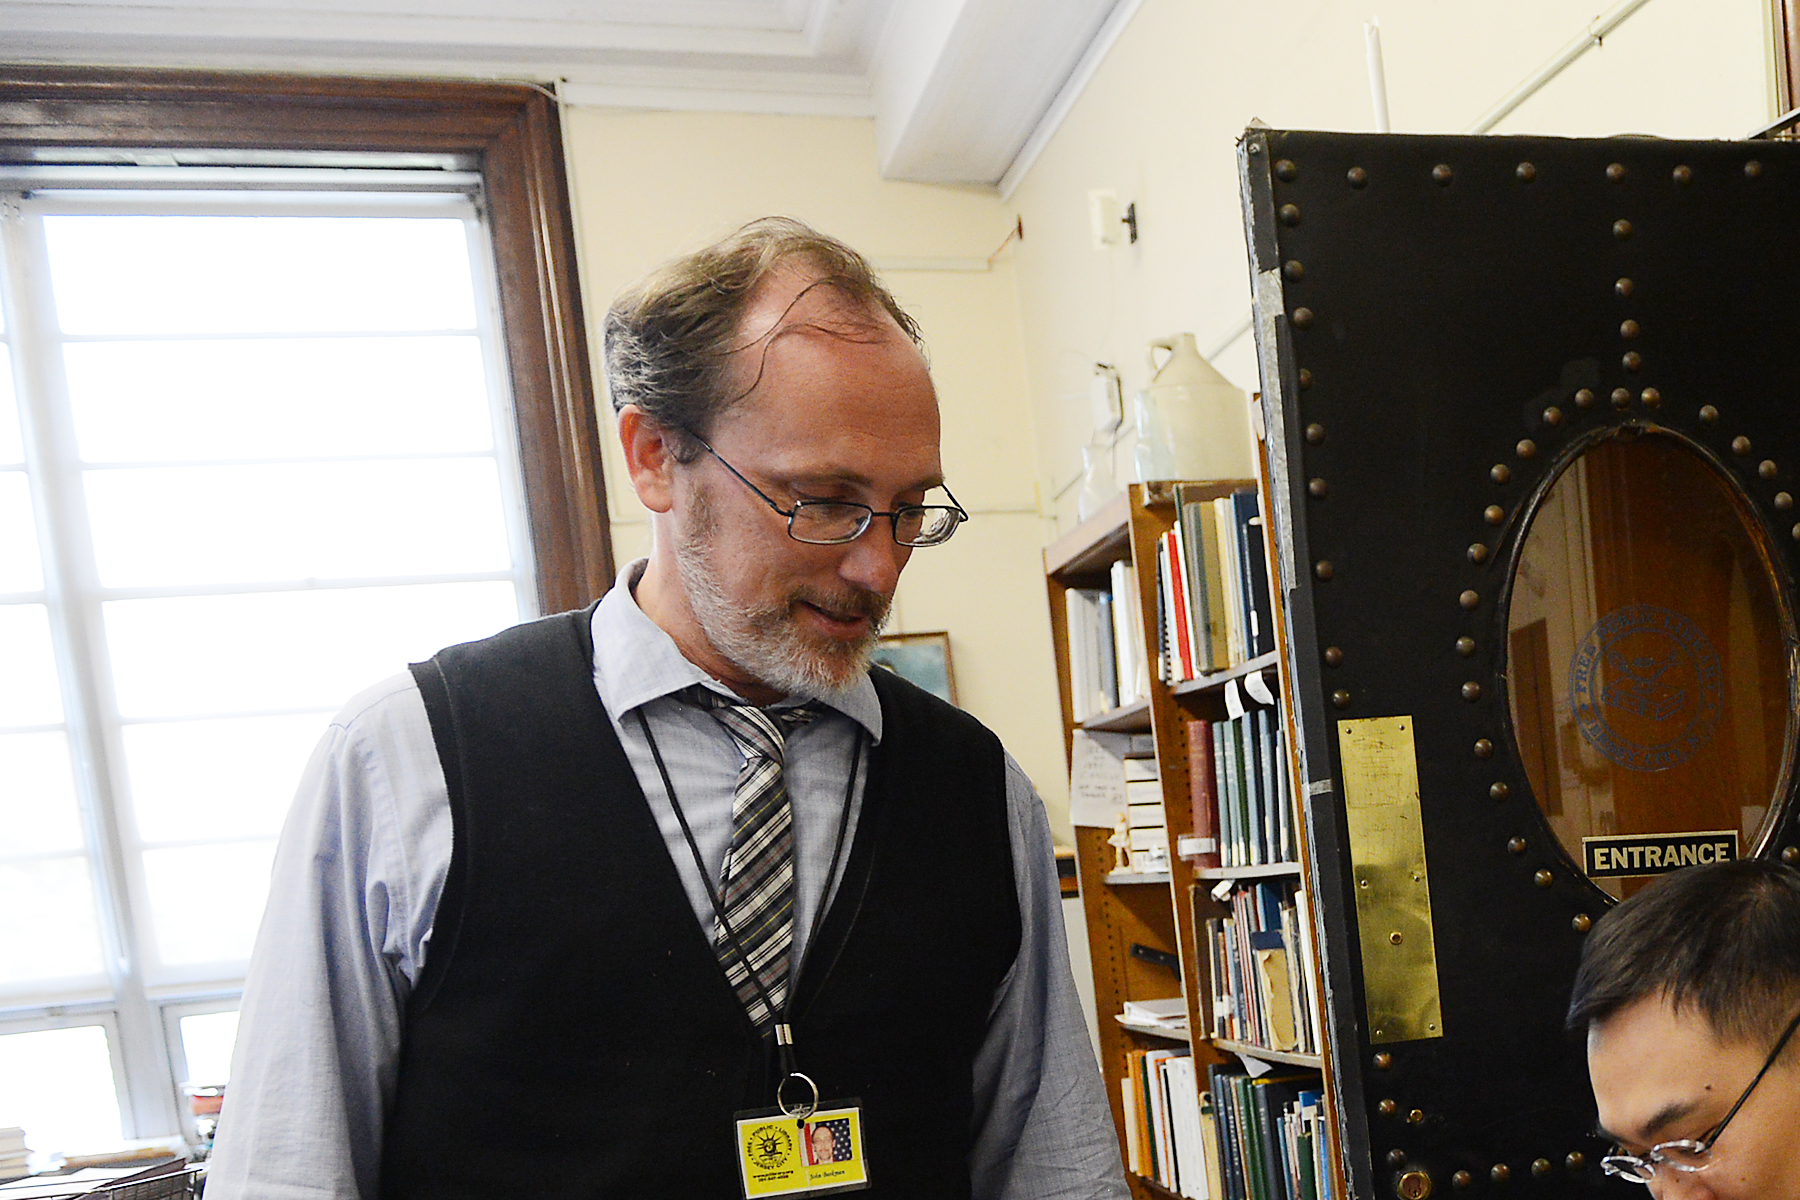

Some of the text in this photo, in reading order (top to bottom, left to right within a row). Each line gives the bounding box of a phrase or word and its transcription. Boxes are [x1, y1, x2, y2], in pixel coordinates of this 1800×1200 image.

[1575, 611, 1719, 694] FREE PUBLIC LIBRARY
[1593, 842, 1730, 871] ENTRANCE
[752, 1125, 773, 1137] PUBLIC
